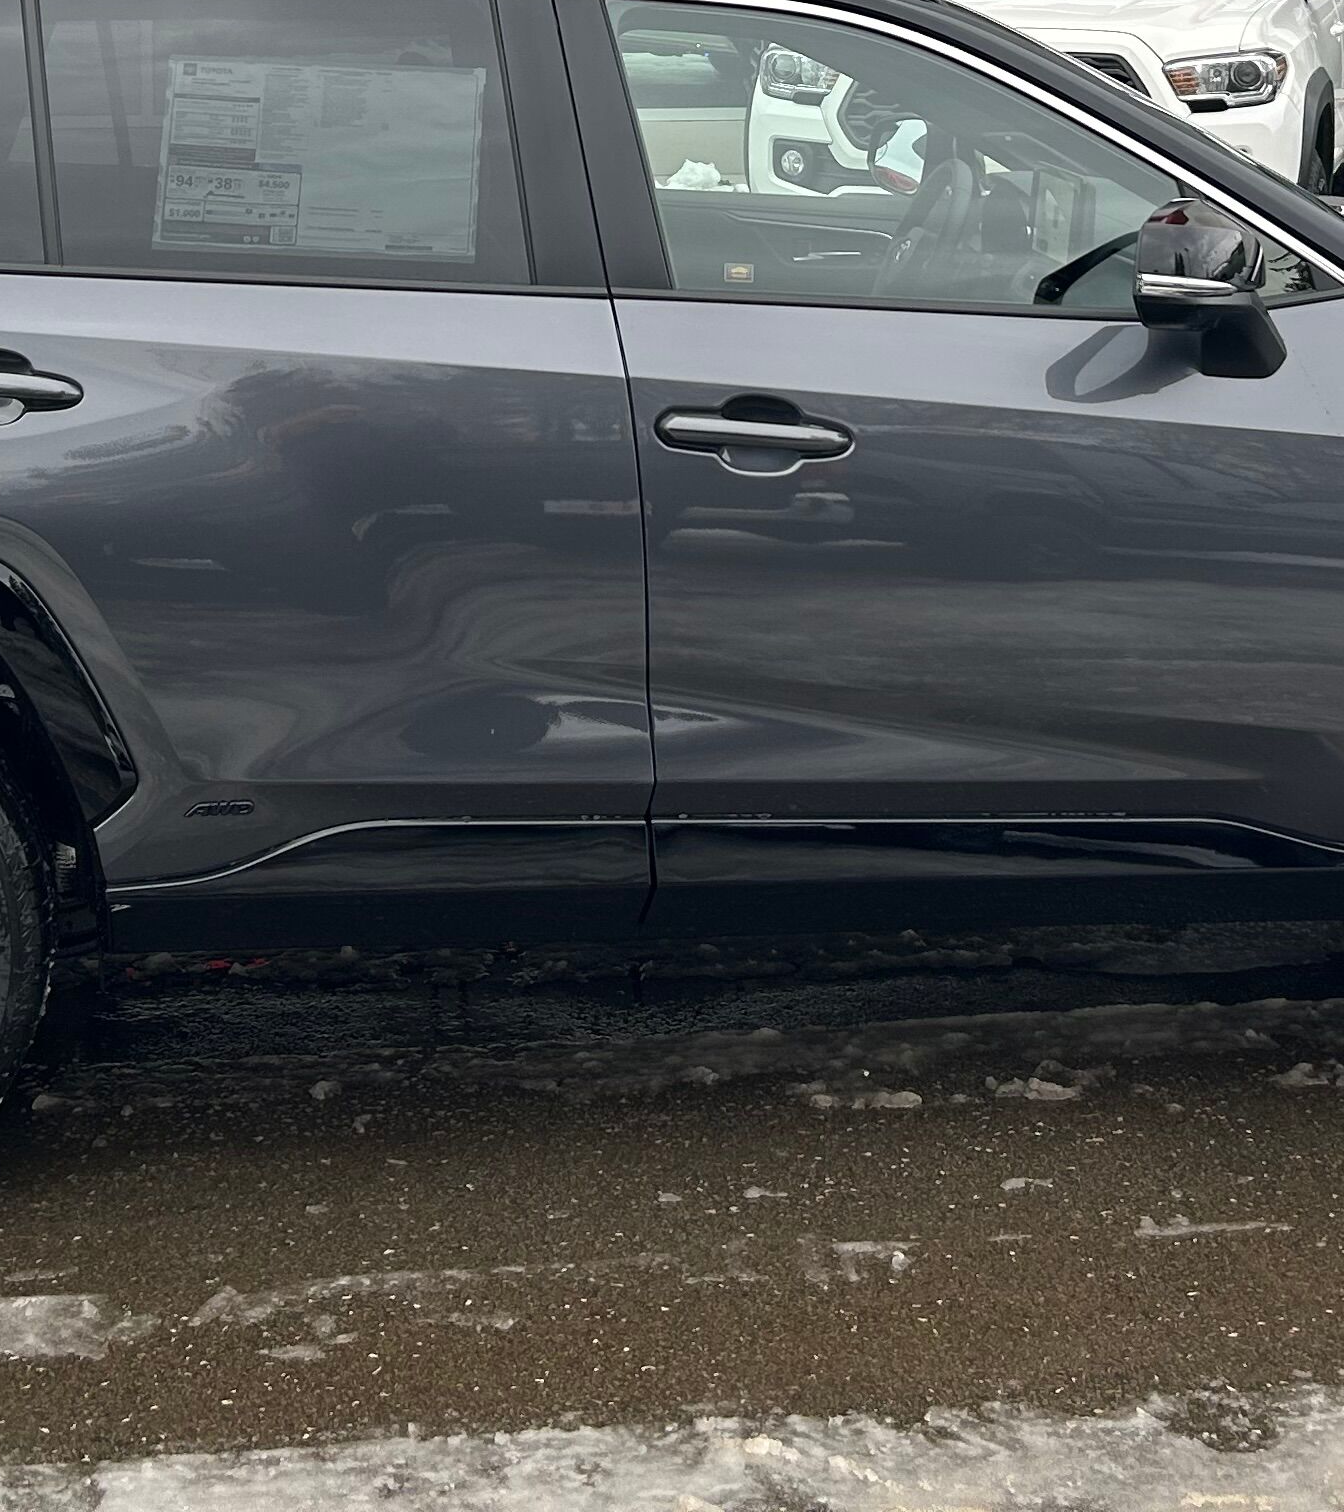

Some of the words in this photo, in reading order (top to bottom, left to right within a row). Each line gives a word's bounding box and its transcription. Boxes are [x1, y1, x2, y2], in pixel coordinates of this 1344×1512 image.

[175, 174, 194, 188] 94
[214, 177, 233, 190] 38
[184, 799, 255, 818] AWD
